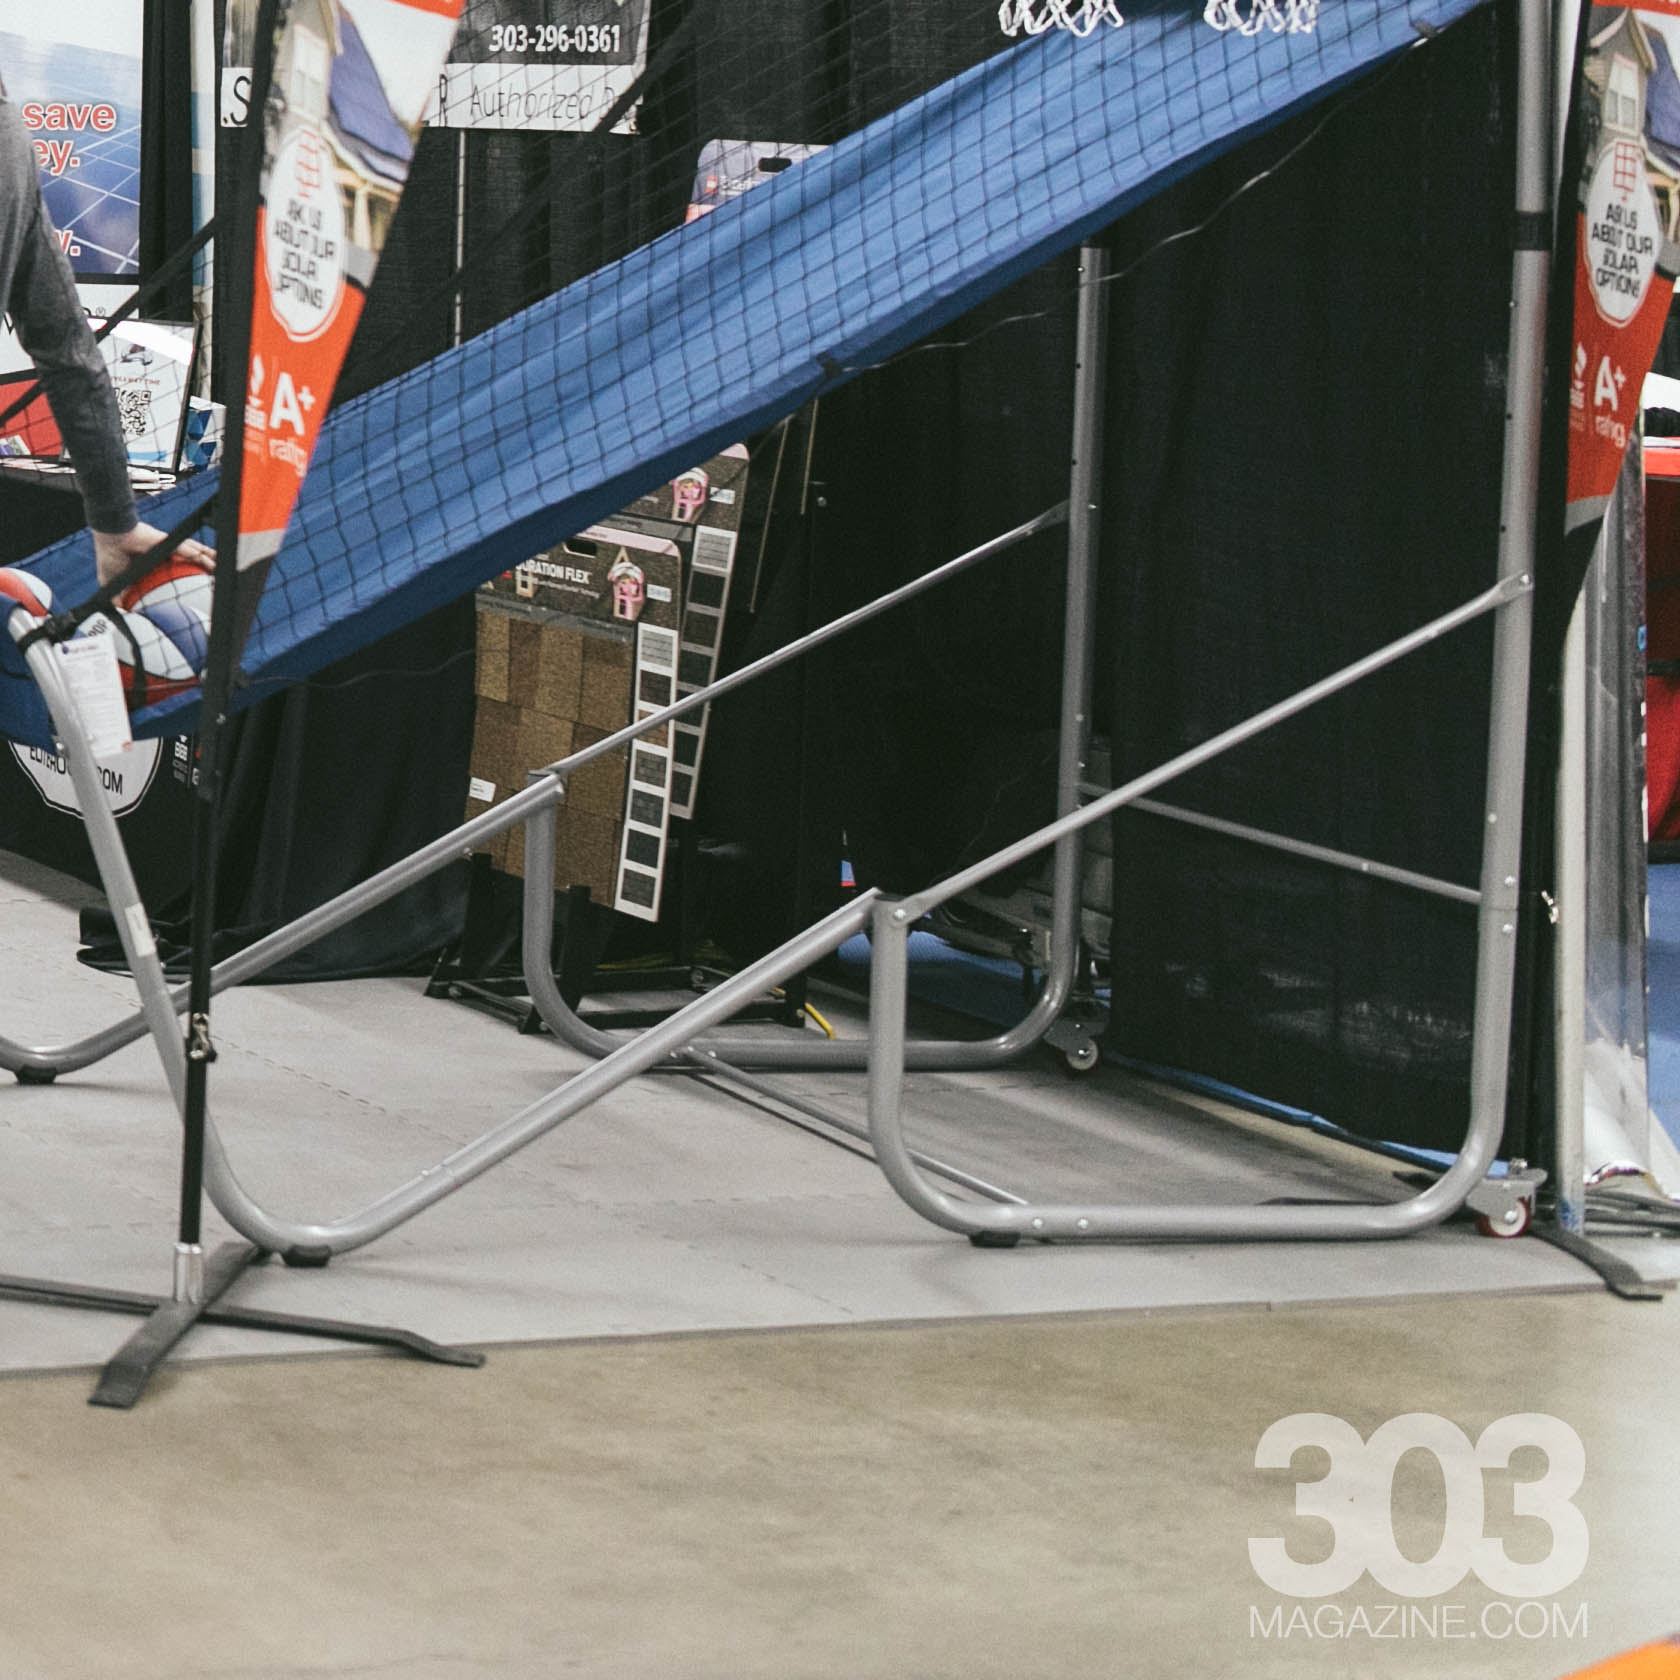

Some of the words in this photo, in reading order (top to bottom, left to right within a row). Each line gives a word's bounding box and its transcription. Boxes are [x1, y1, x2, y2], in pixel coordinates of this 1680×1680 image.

[489, 24, 621, 53] 303-296-0361
[23, 102, 117, 132] save
[470, 84, 593, 121] Authorized
[1626, 232, 1653, 256] OUR
[1594, 356, 1627, 412] A+
[269, 372, 316, 435] A+
[516, 559, 564, 579] URATION
[565, 566, 589, 584] FLEX
